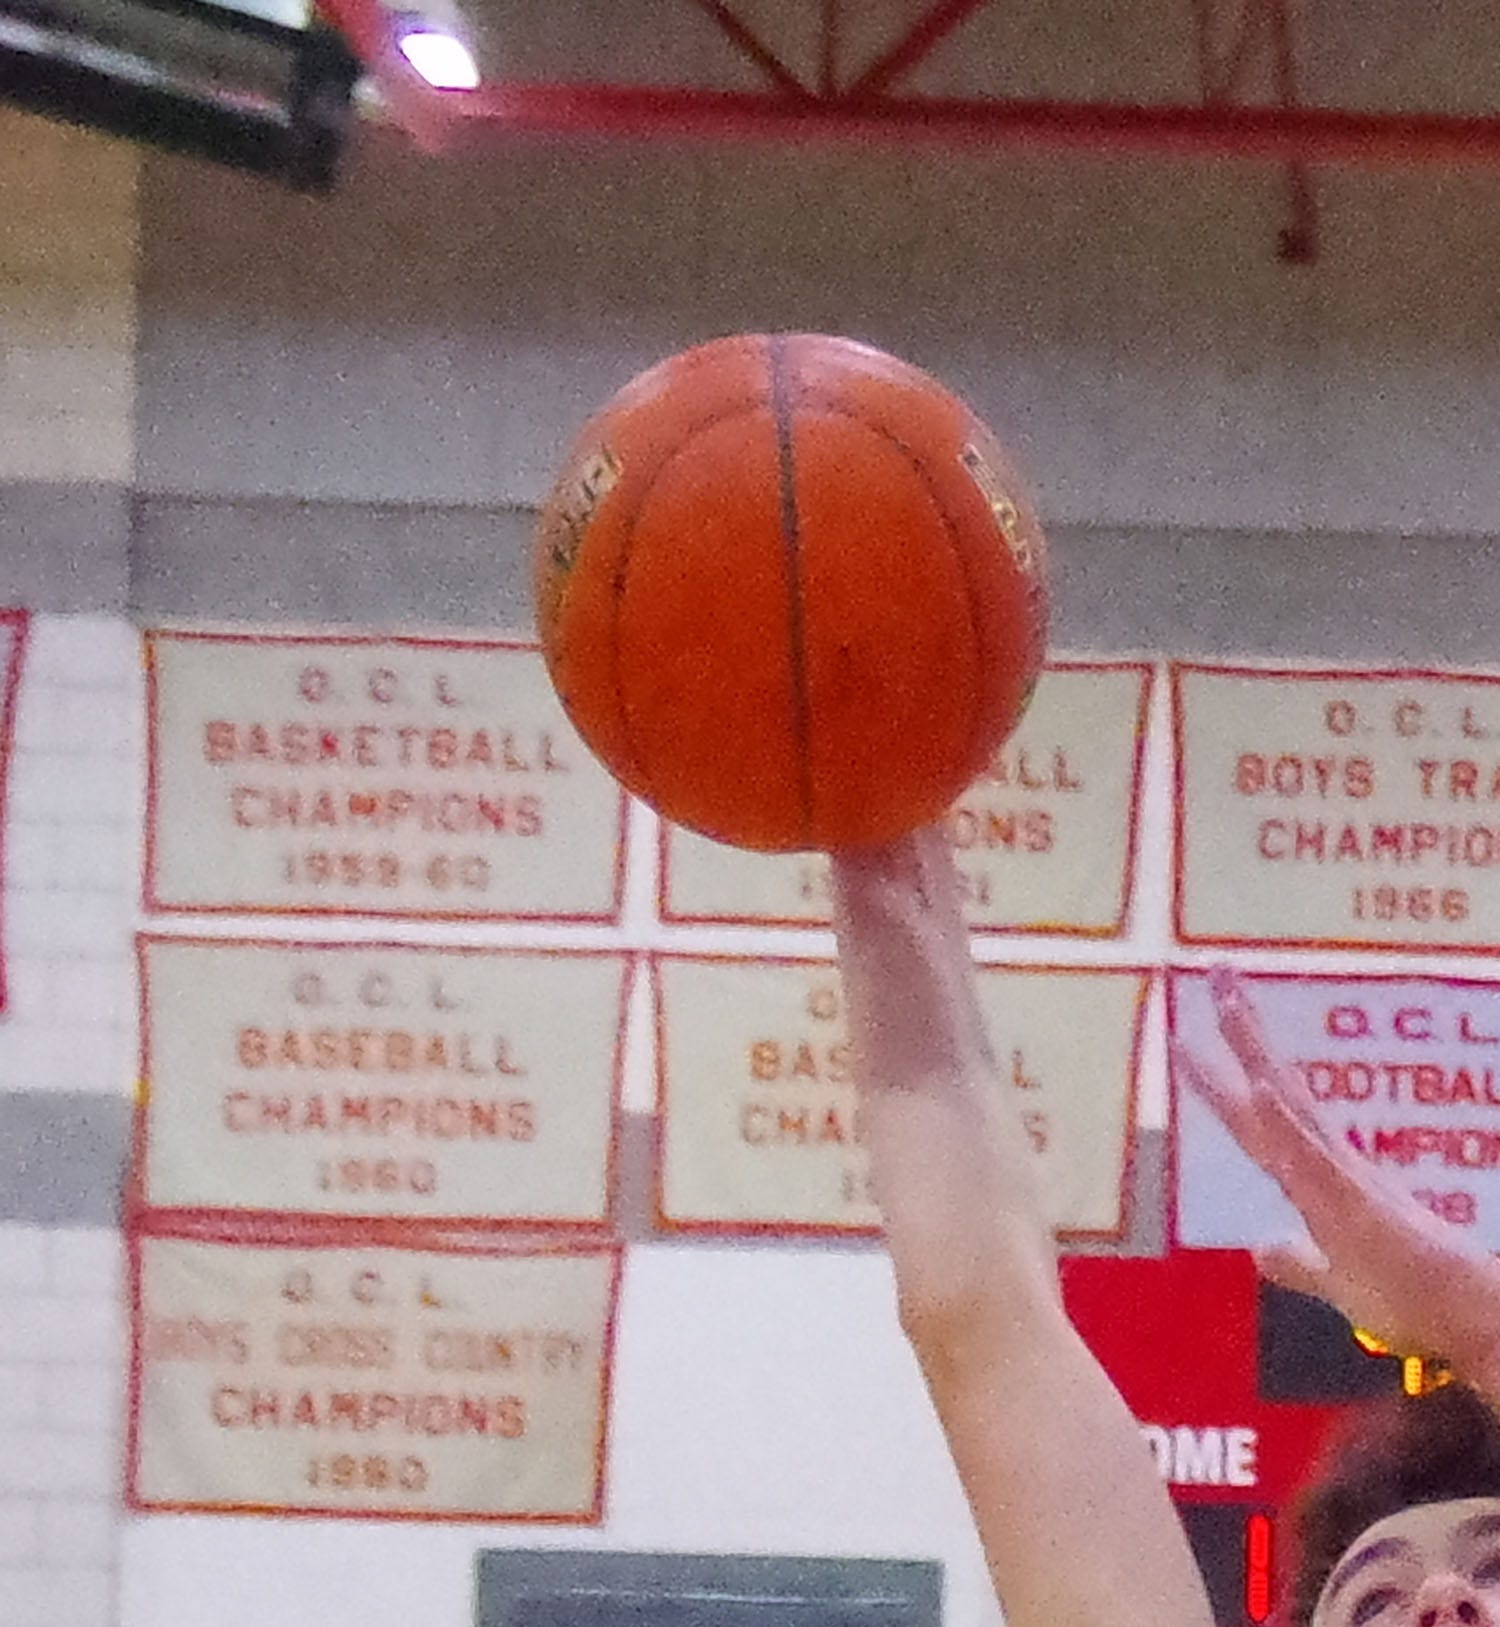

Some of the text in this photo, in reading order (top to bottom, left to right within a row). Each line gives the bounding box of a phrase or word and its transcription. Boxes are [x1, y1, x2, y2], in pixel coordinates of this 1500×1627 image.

[204, 721, 568, 773] BASKETBALL
[1234, 753, 1376, 799] BOYS
[233, 787, 542, 836] CHAMPIONS
[238, 1028, 528, 1076] BASEBALL
[223, 1090, 536, 1141] CHAMPIONS
[212, 1384, 527, 1438] CHAMPIONS
[1139, 1425, 1260, 1486] OME
